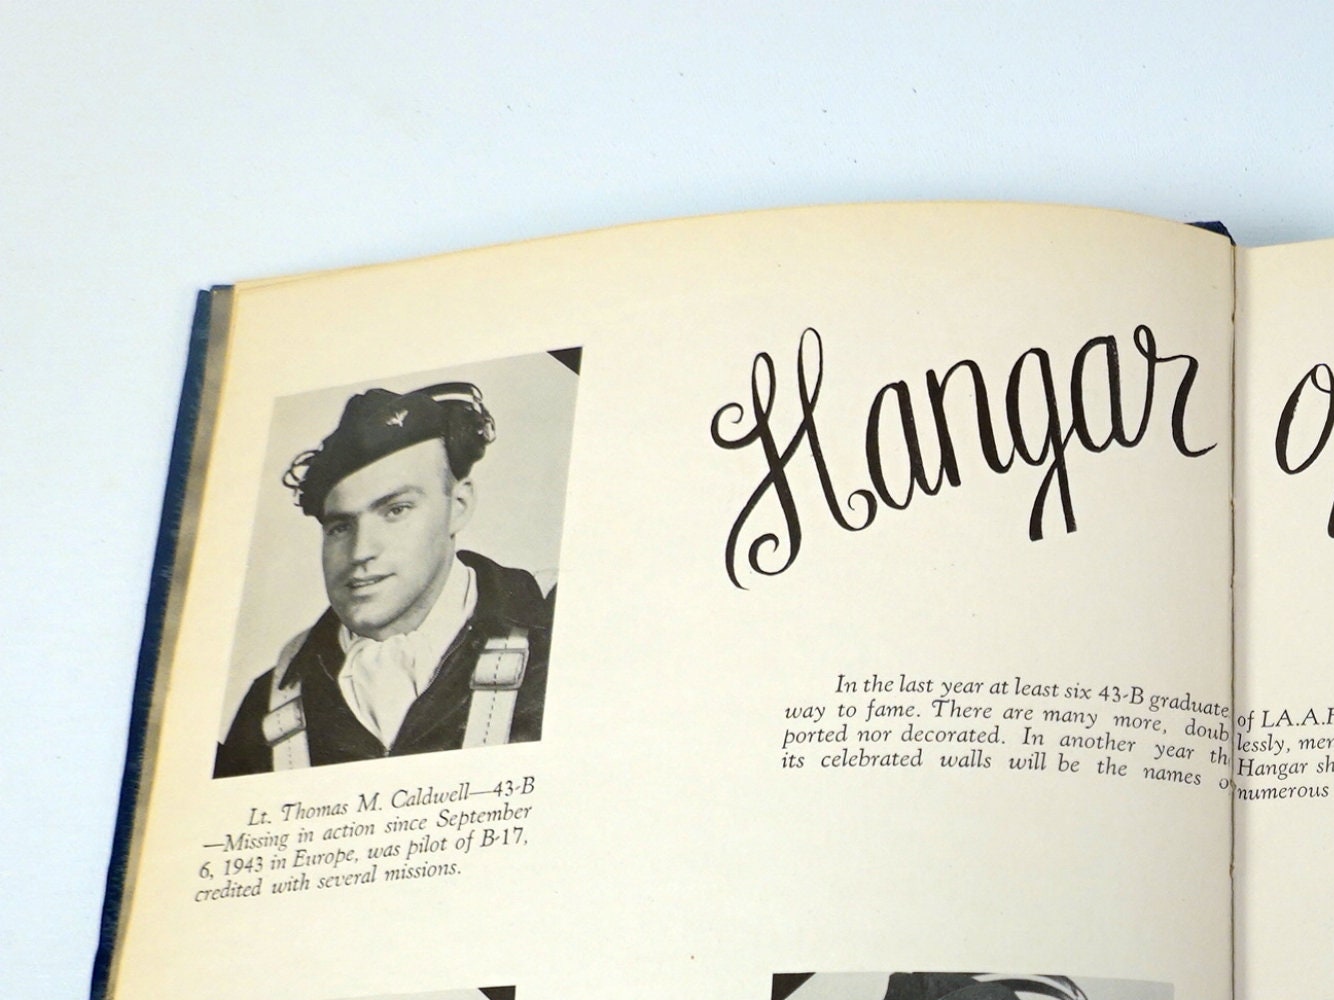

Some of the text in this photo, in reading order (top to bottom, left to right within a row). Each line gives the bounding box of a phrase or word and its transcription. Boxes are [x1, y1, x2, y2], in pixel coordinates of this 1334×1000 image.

[710, 325, 1217, 591] Hangar
[834, 673, 1145, 705] In the last year at least six 43-B
[784, 697, 1167, 735] way to fame. There are many more,
[1236, 709, 1255, 733] of
[1236, 732, 1291, 756] lessly,
[781, 747, 1202, 786] its celebrated walls will be the names
[246, 807, 272, 827] Lt.
[280, 801, 349, 822] Thomas
[356, 791, 383, 813] M.
[1237, 780, 1330, 801] numerous
[297, 827, 314, 844] in
[322, 821, 376, 841] action
[383, 815, 428, 834] since
[435, 801, 533, 832] September
[194, 860, 462, 903] credited with several missions.
